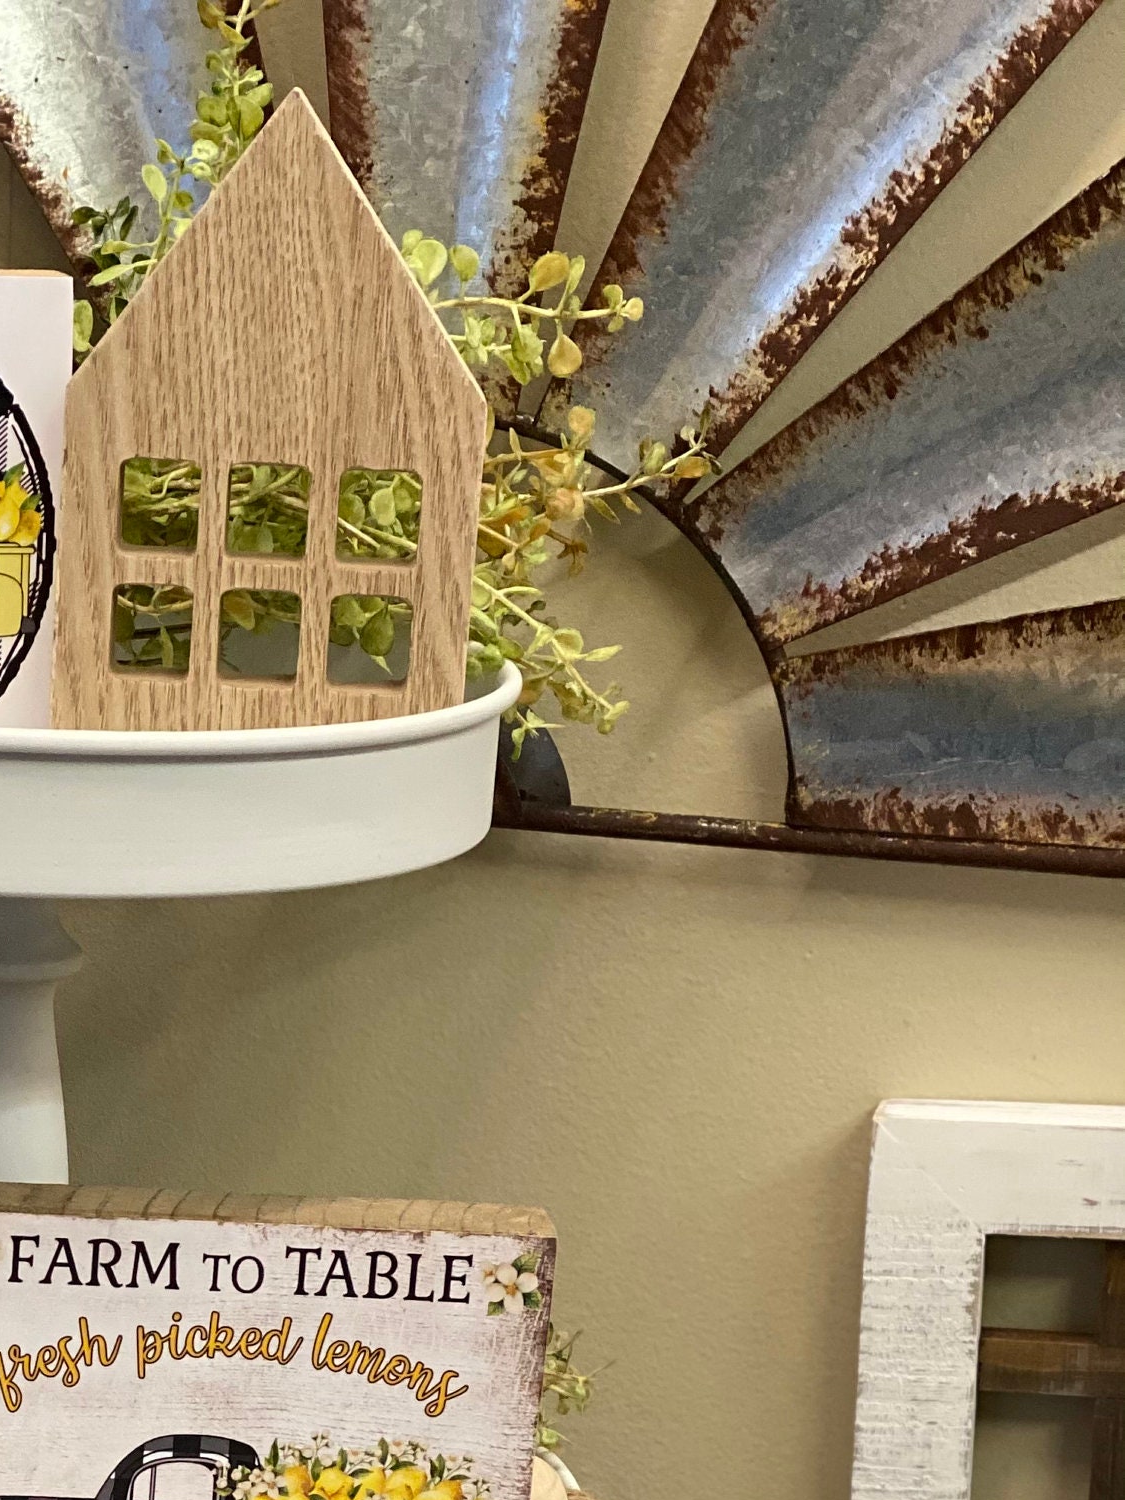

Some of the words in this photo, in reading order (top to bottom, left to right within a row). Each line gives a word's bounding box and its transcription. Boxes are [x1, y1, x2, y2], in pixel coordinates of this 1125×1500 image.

[7, 1234, 181, 1291] FARM
[202, 1253, 266, 1295] TO
[285, 1245, 474, 1305] TABLE
[137, 1310, 304, 1379] picked
[311, 1313, 469, 1418] lemons
